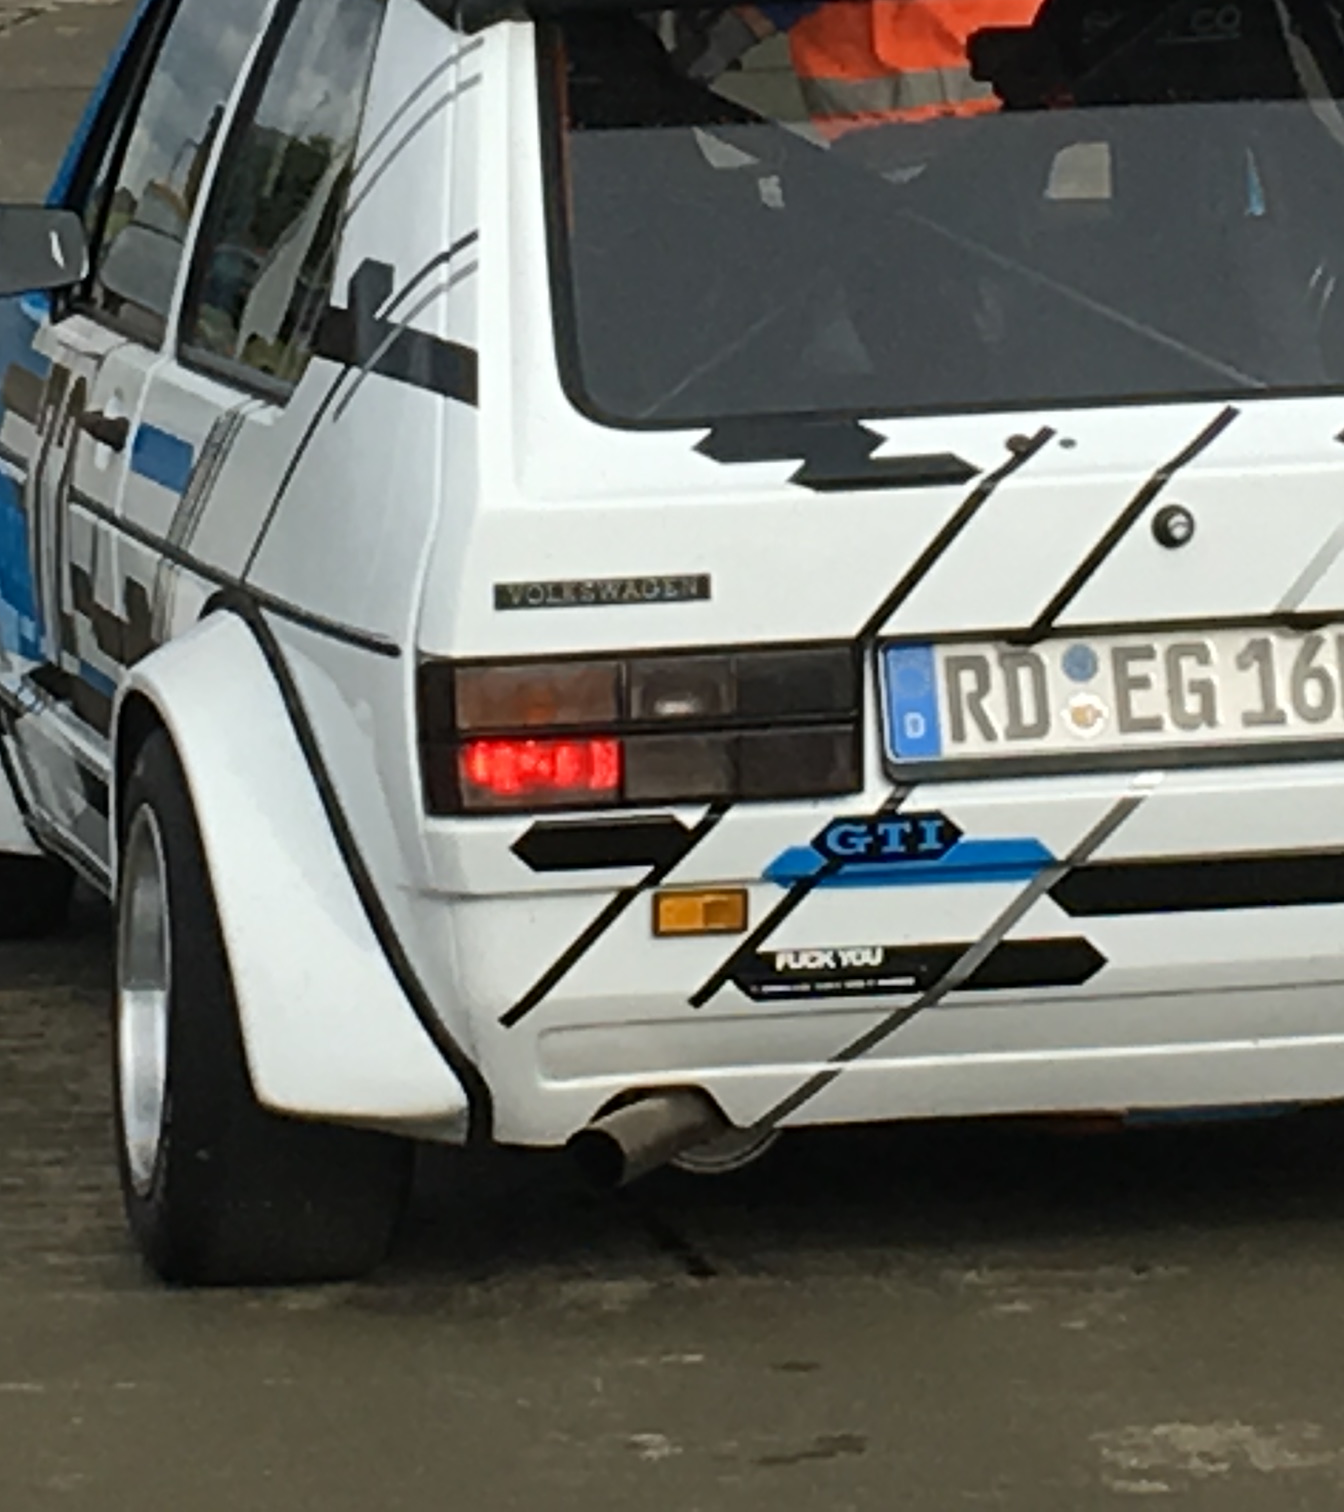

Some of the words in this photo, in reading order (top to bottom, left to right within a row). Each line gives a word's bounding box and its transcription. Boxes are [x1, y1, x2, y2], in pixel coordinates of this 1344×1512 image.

[507, 578, 698, 604] VOLKSWAGEN
[944, 651, 1052, 745] RD
[1111, 640, 1219, 735] EG
[826, 819, 944, 854] GTI
[775, 950, 836, 971] FUCK
[839, 946, 883, 967] YOU
